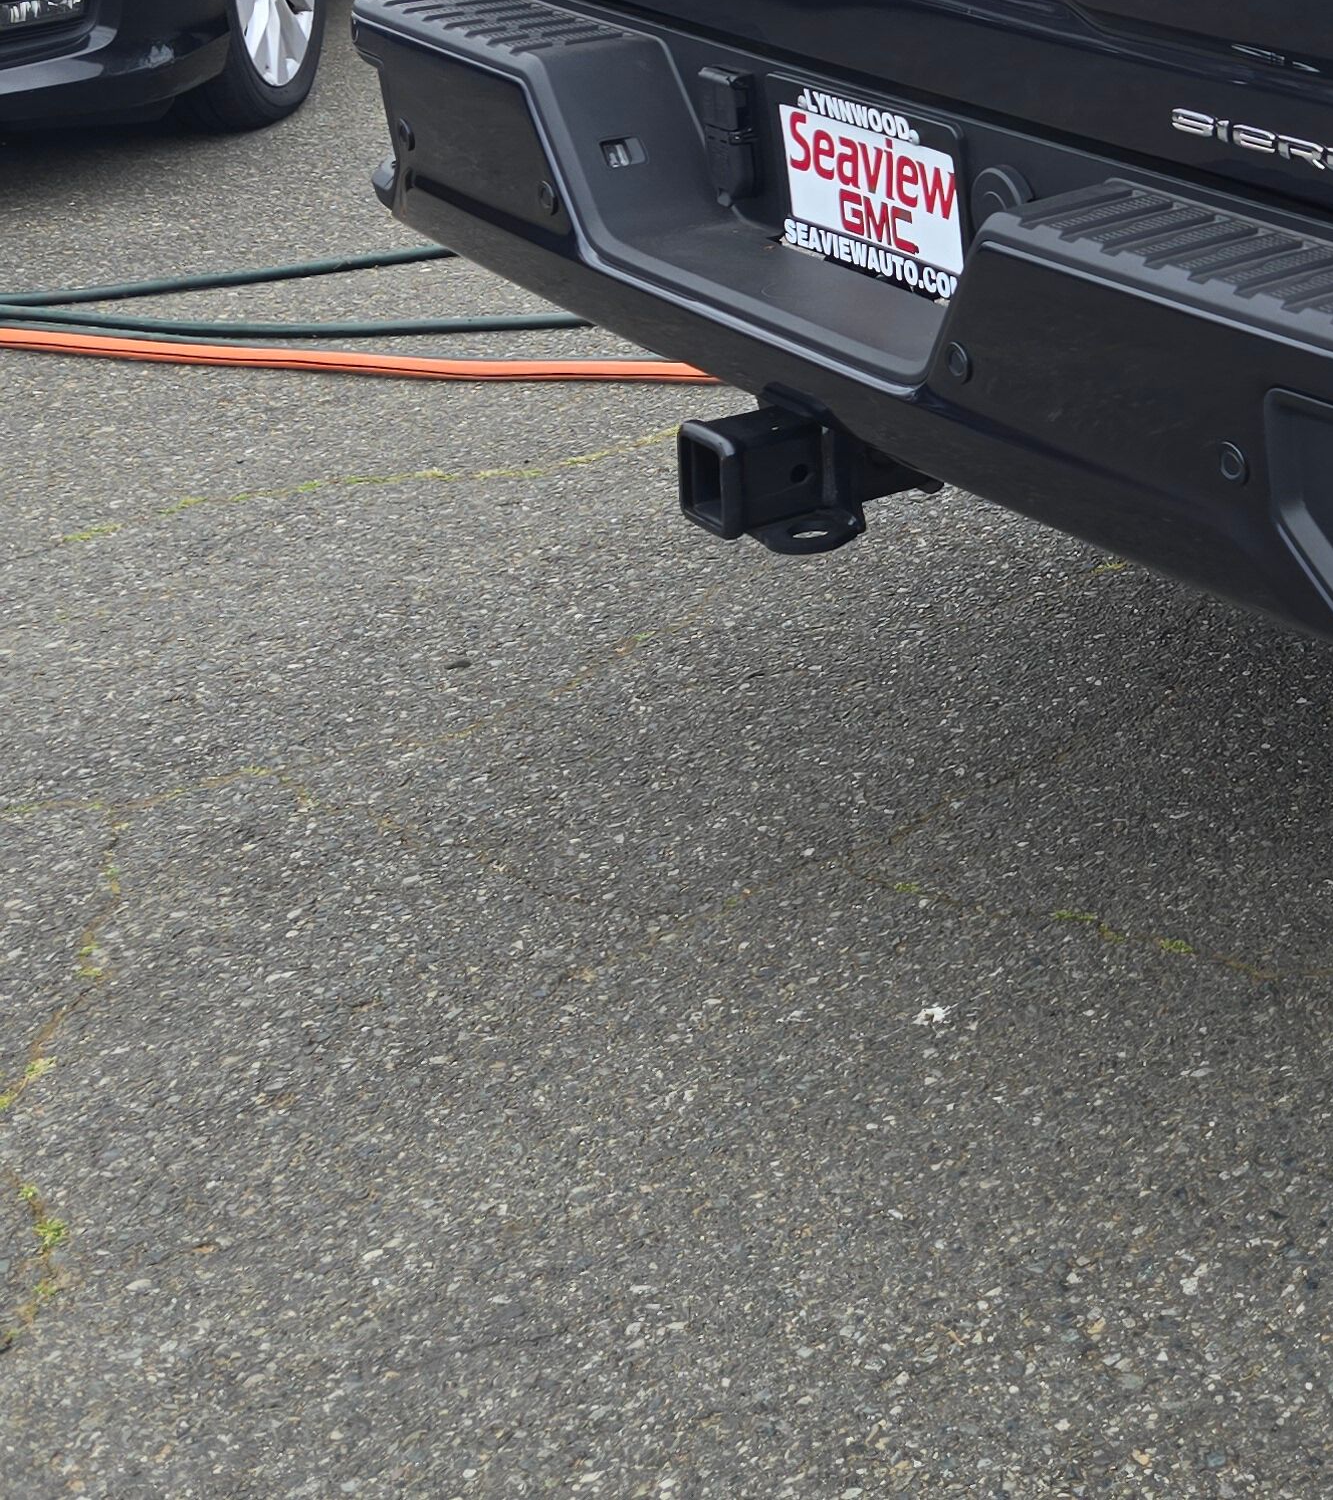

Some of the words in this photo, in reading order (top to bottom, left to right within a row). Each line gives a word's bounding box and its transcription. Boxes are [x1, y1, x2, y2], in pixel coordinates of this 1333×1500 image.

[803, 88, 911, 140] LYNNWOOD
[789, 111, 957, 219] Seaview
[839, 188, 919, 255] GMC
